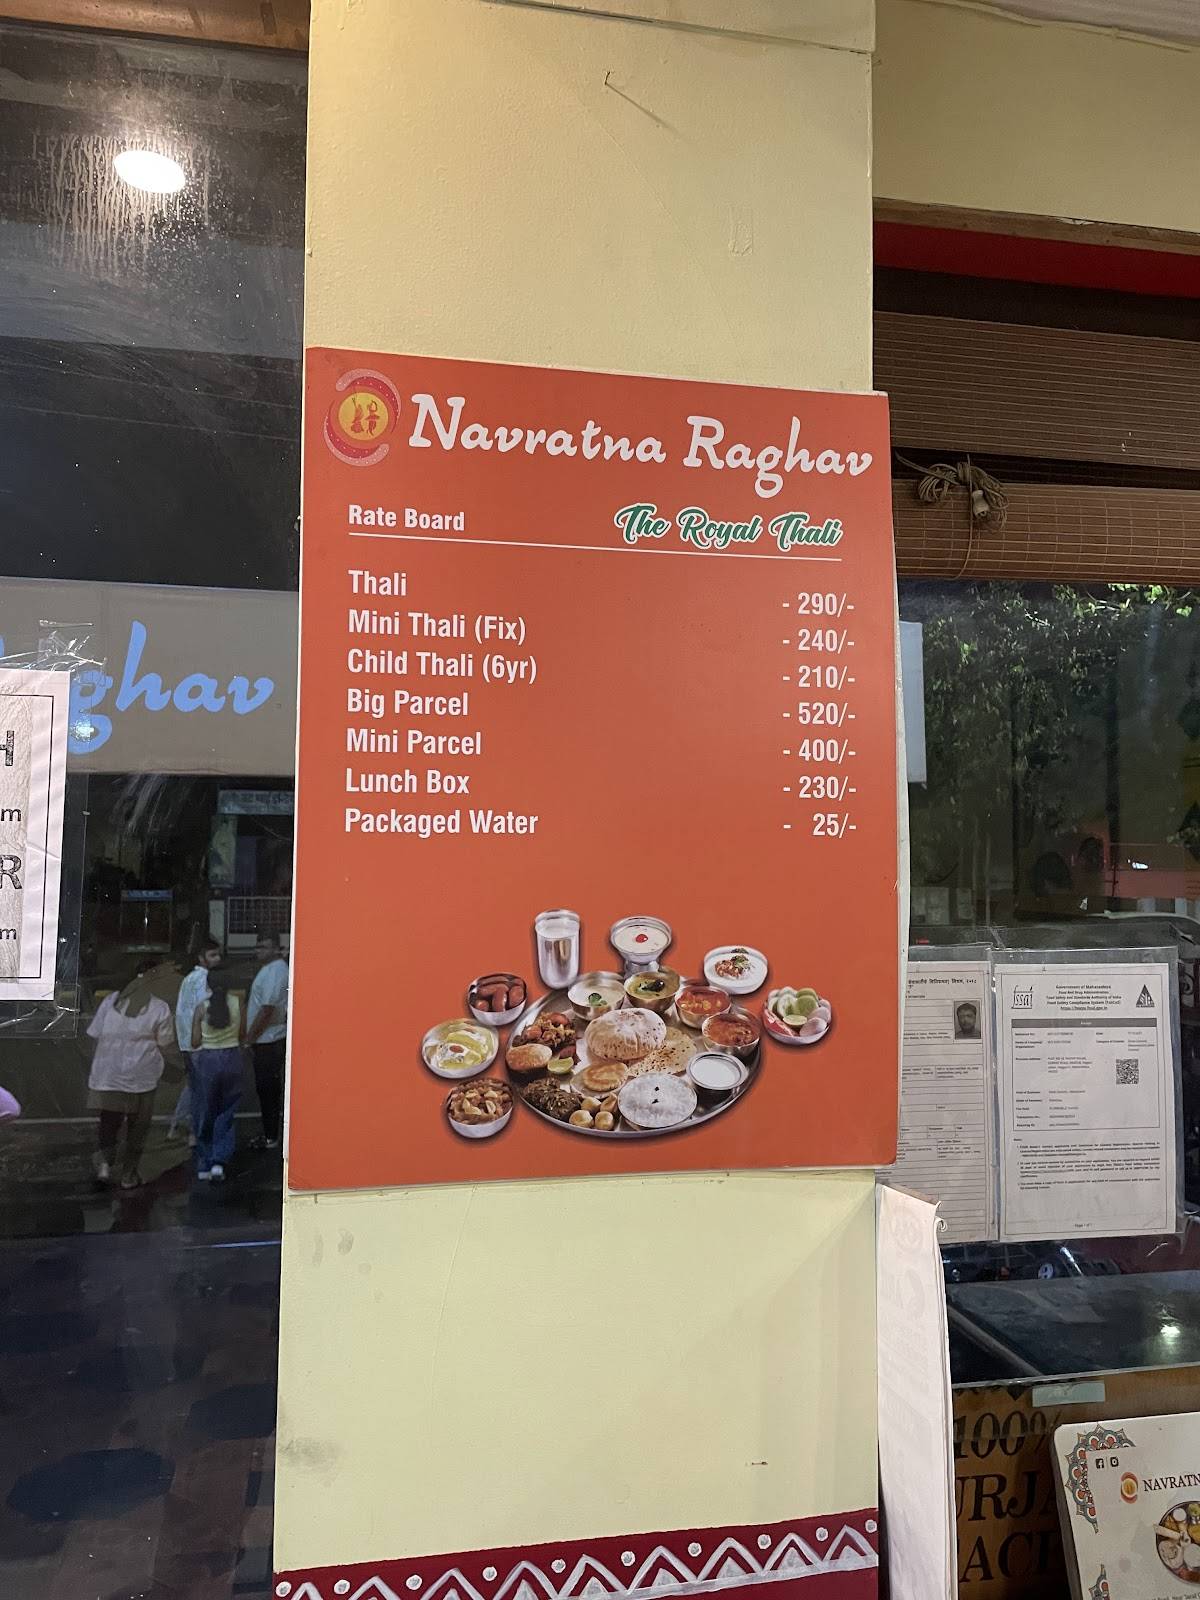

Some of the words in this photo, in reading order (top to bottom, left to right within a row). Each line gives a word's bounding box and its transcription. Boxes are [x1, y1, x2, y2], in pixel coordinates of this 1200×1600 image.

[408, 393, 667, 464] Navratna
[682, 415, 873, 499] Raghav
[348, 504, 397, 528] Rate
[404, 507, 465, 532] Board
[613, 502, 671, 544] The
[677, 506, 764, 550] Royal
[768, 511, 844, 551] Thali
[347, 569, 407, 597] Thali
[798, 592, 855, 618] 290/-
[348, 608, 400, 635] Mini
[407, 611, 466, 638] Thali
[474, 614, 526, 646] (Fix)
[798, 628, 855, 654] 240/-
[68, 620, 275, 755] ghav
[347, 648, 408, 675] Child
[415, 651, 473, 677] Thali
[482, 653, 537, 685] (6yr)
[798, 665, 856, 691] 210/-
[347, 687, 385, 719] Big
[394, 689, 469, 716] Parcel
[798, 702, 856, 728] 520/-
[346, 727, 399, 753] Mini
[407, 729, 482, 756] Parcel
[798, 738, 856, 765] 400/-
[345, 767, 418, 794] Lunch
[426, 769, 470, 794] Box
[798, 775, 857, 801] 230/-
[345, 807, 461, 839] Packaged
[469, 809, 539, 835] Water
[812, 812, 857, 838] 25/-
